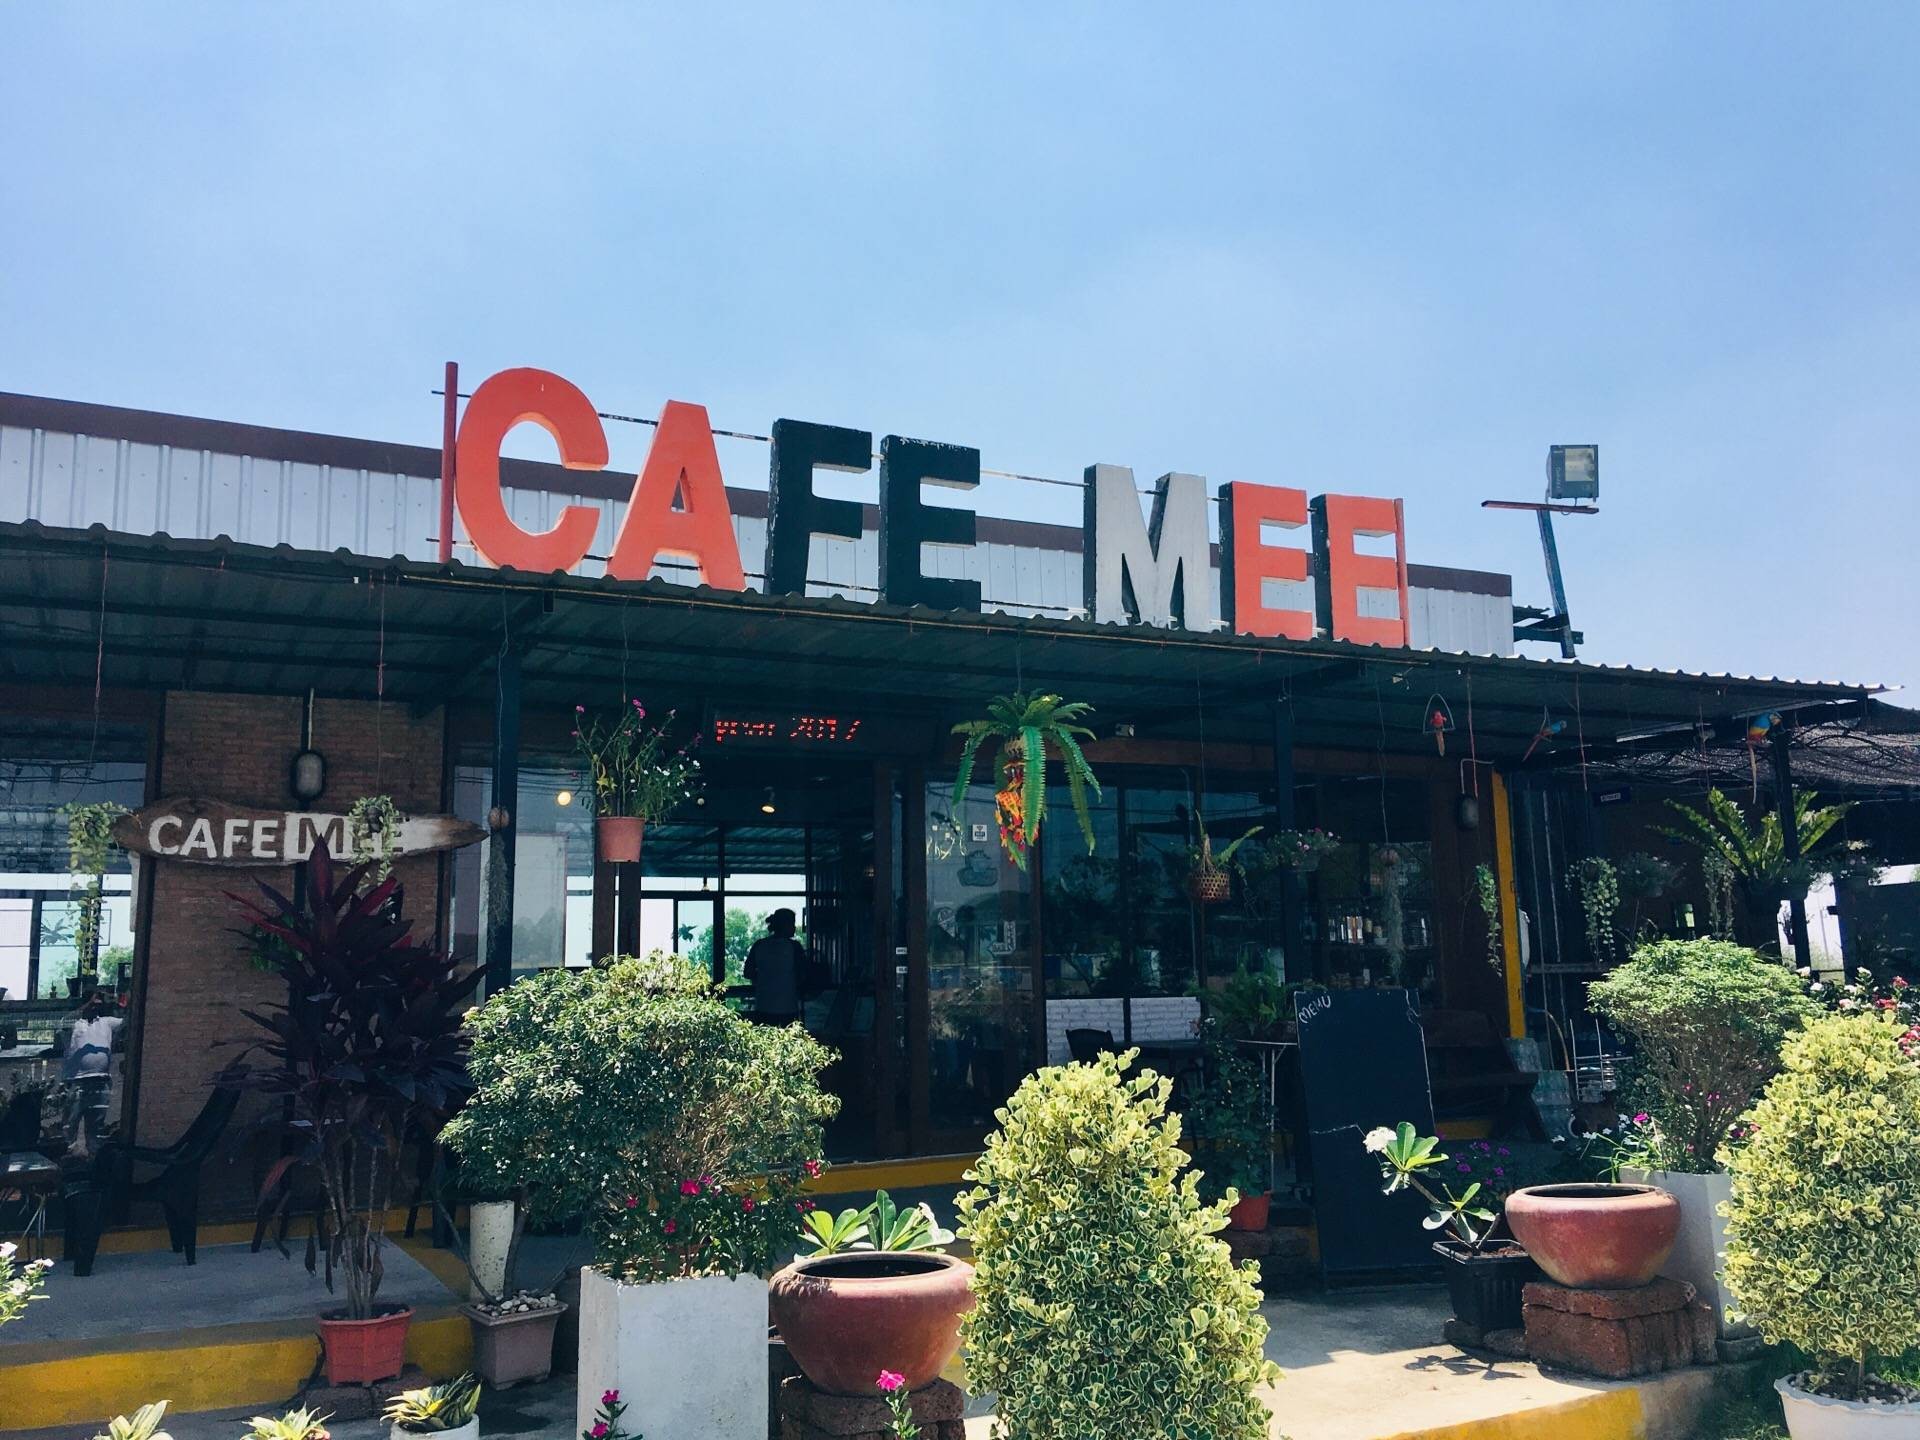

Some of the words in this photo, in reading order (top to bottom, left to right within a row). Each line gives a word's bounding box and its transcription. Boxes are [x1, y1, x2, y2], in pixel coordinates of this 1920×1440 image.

[455, 367, 981, 612] CAFE
[1084, 463, 1404, 648] MEE
[148, 815, 278, 859] CAFE
[1298, 994, 1332, 1024] MENU
